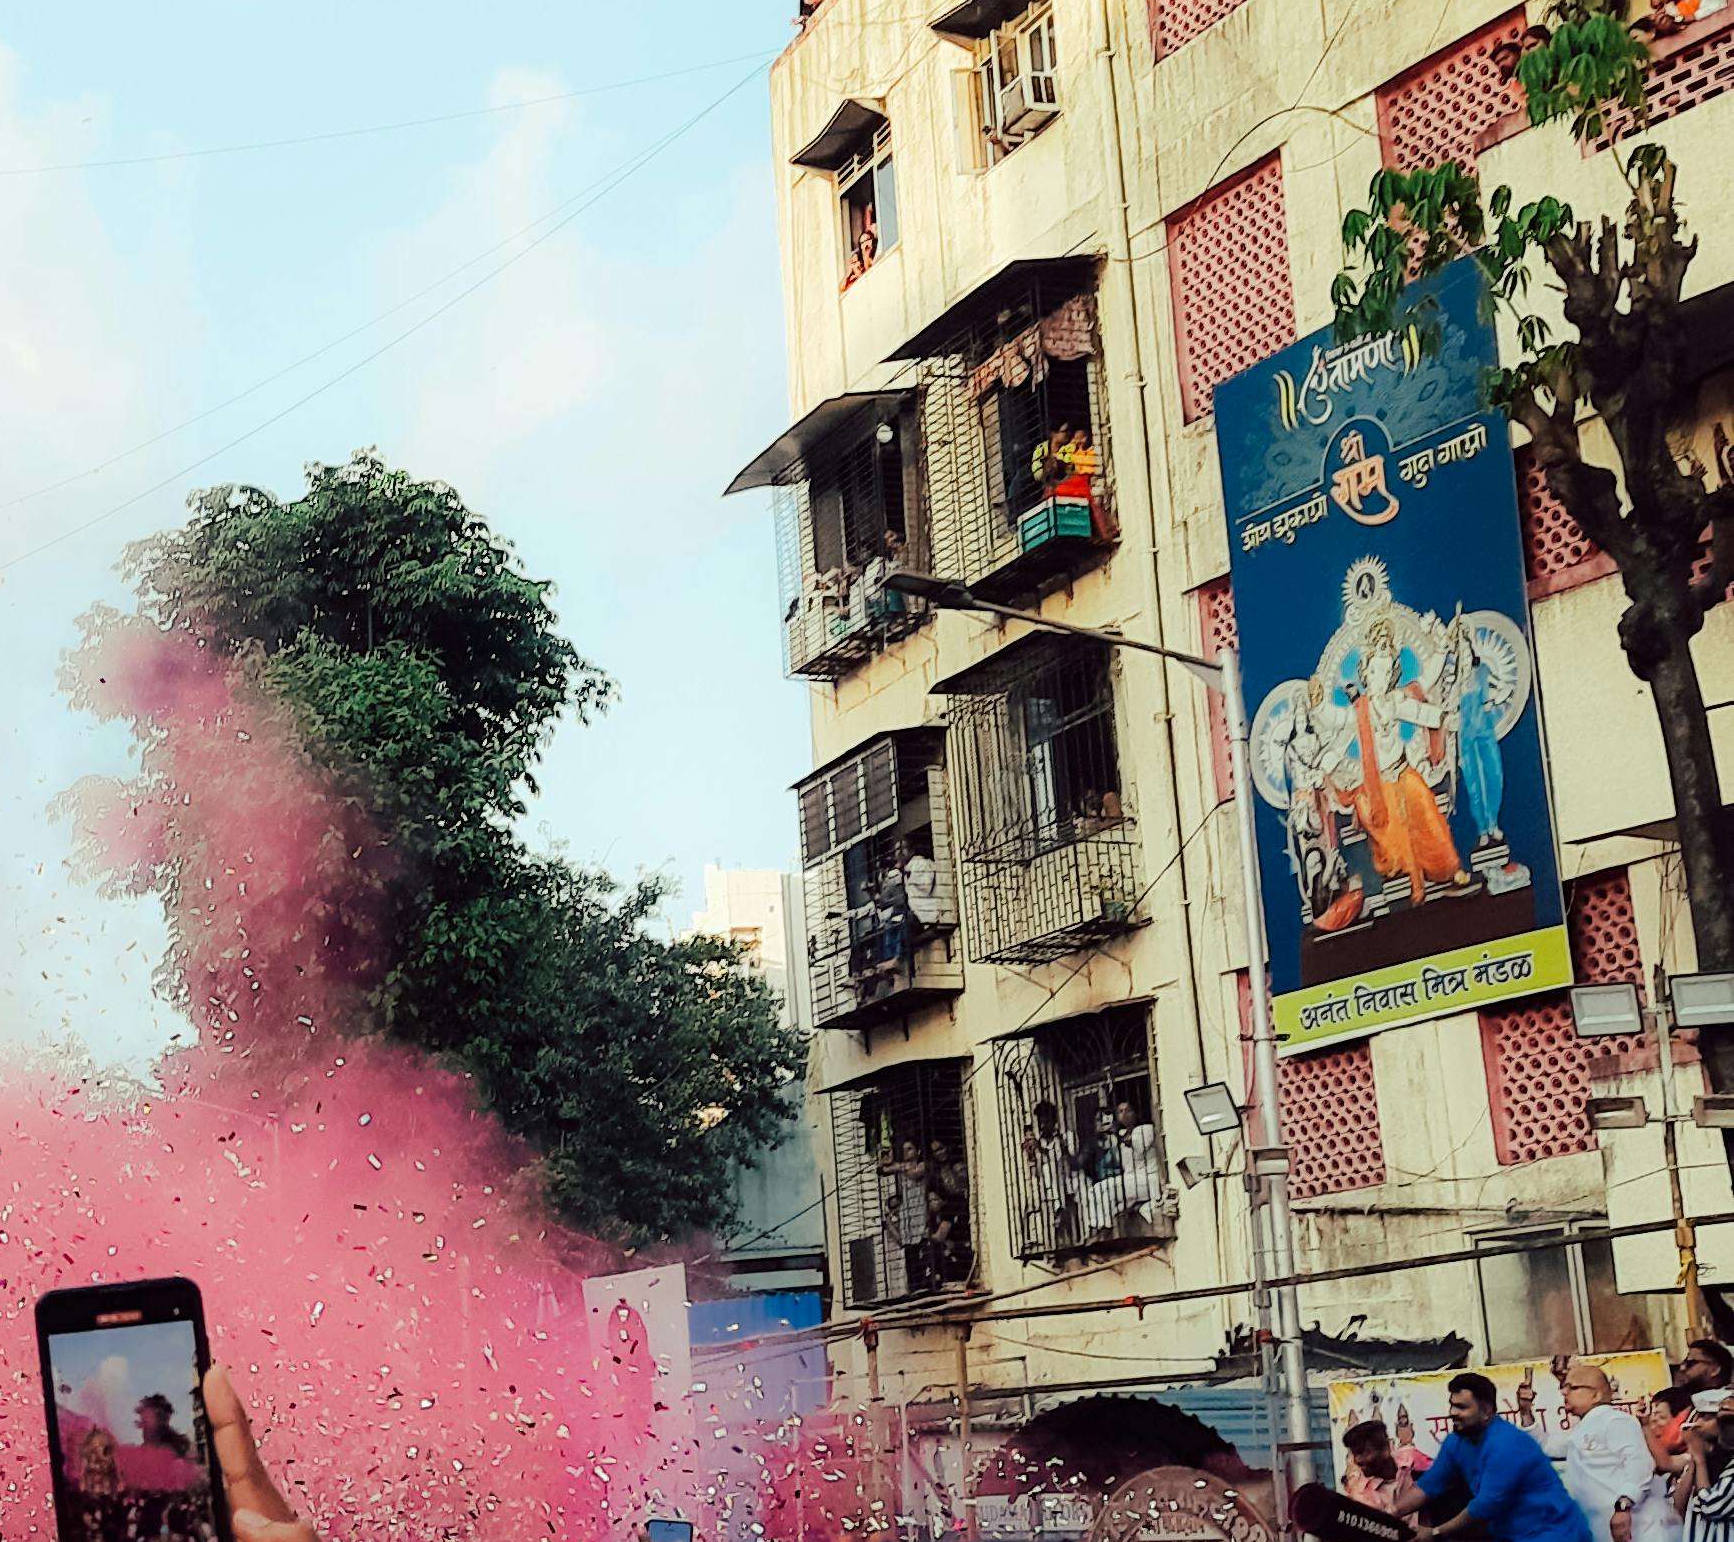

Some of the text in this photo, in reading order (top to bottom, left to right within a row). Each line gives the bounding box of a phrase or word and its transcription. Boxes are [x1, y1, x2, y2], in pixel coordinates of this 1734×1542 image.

[1300, 953, 1532, 1031] अनंत निवास मित्र मंडळ
